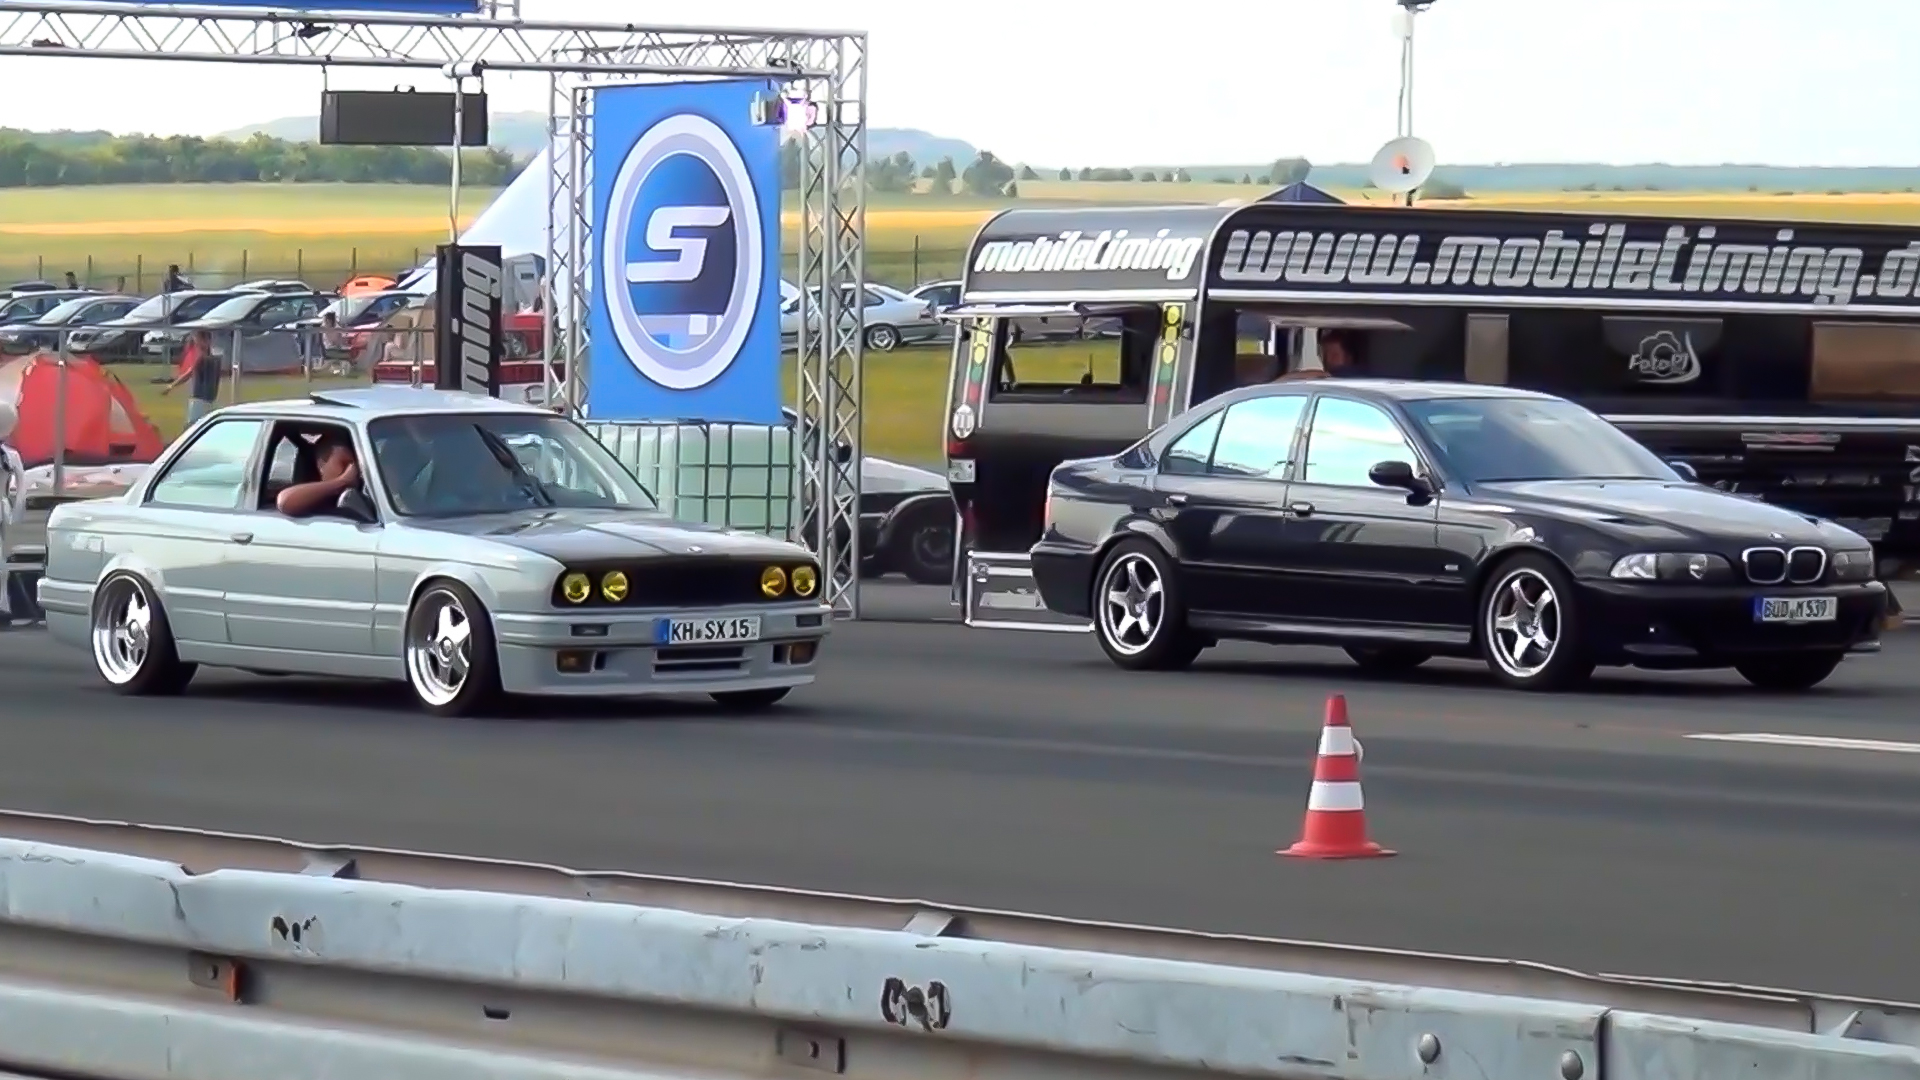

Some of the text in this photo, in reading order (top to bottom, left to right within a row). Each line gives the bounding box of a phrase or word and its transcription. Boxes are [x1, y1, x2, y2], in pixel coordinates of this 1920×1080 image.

[974, 229, 1203, 280] mobiletiming
[1219, 223, 1920, 305] www.mobiletiming.d
[672, 619, 749, 641] KH SX 15
